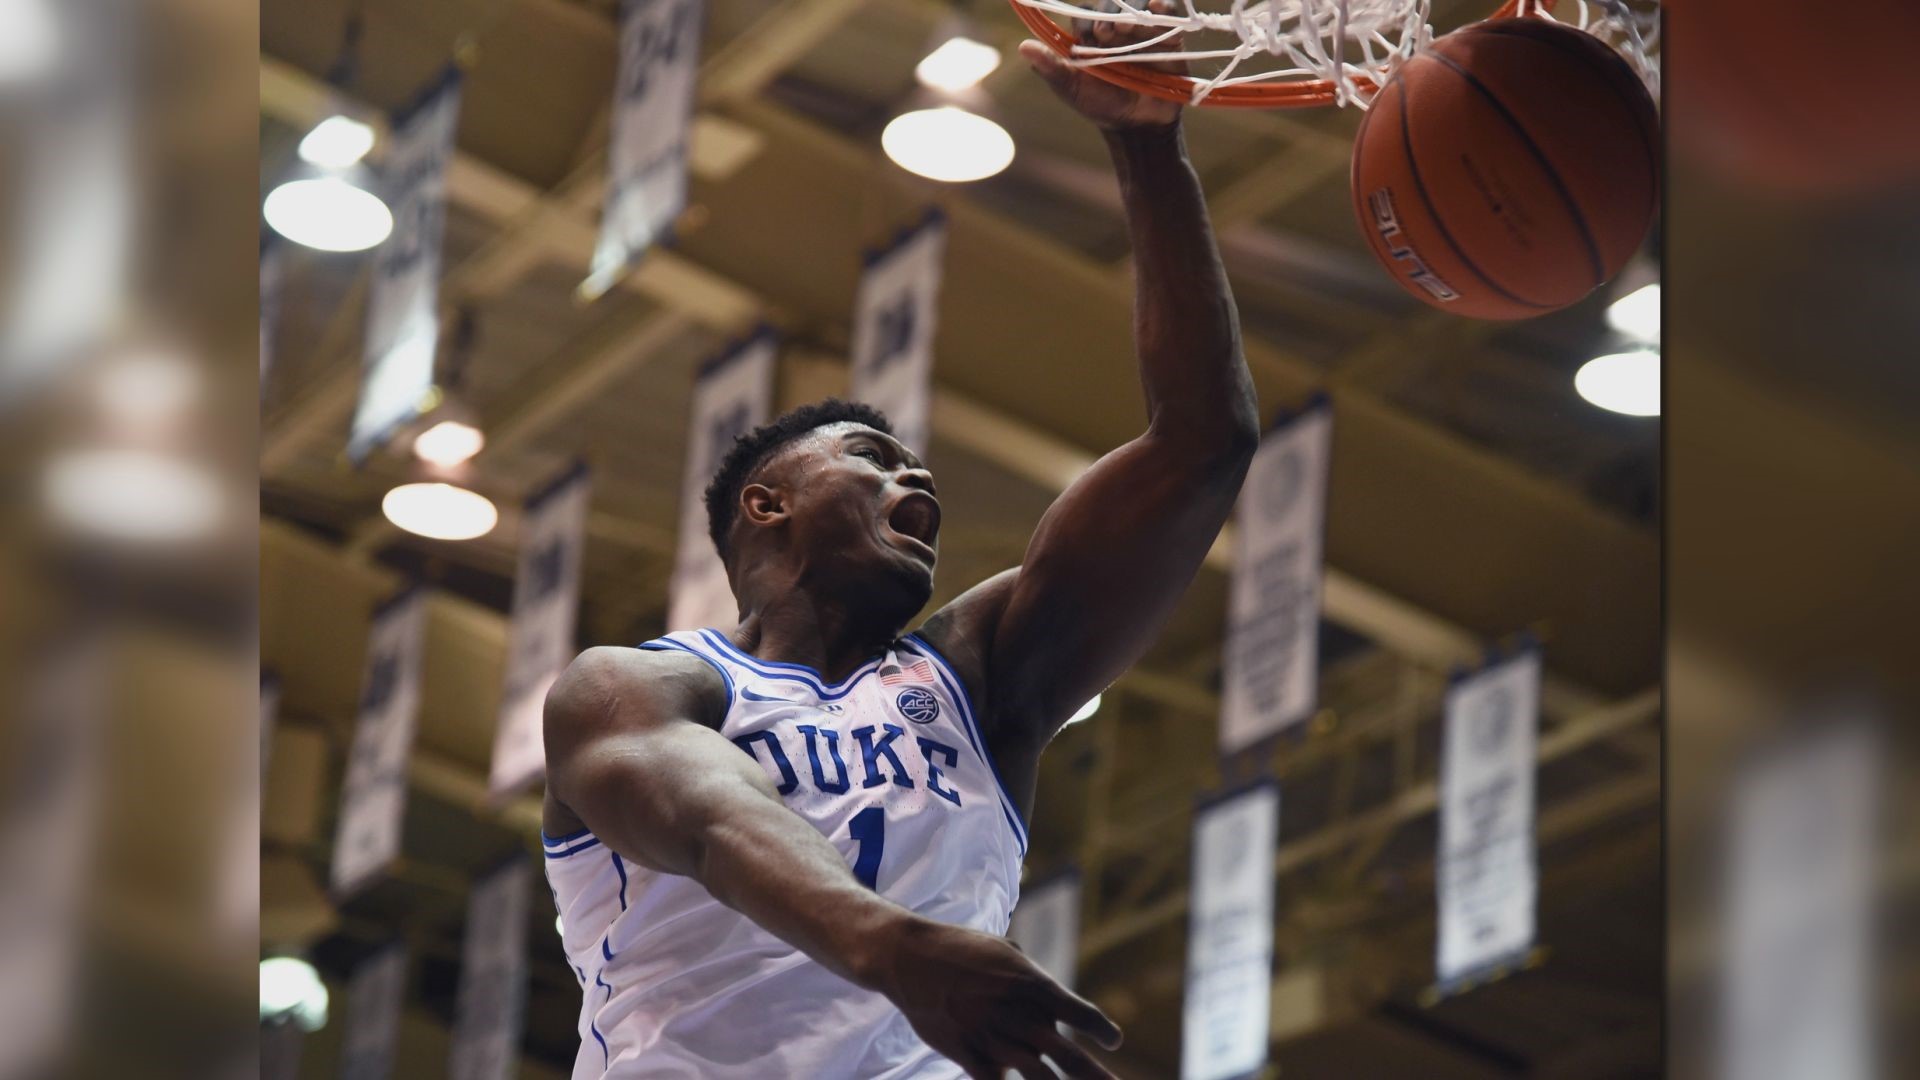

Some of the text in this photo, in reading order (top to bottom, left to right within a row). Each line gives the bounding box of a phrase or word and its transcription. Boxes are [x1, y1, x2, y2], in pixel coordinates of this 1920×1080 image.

[904, 698, 934, 708] ACC
[733, 723, 962, 807] DUKE
[848, 807, 885, 892] 1
